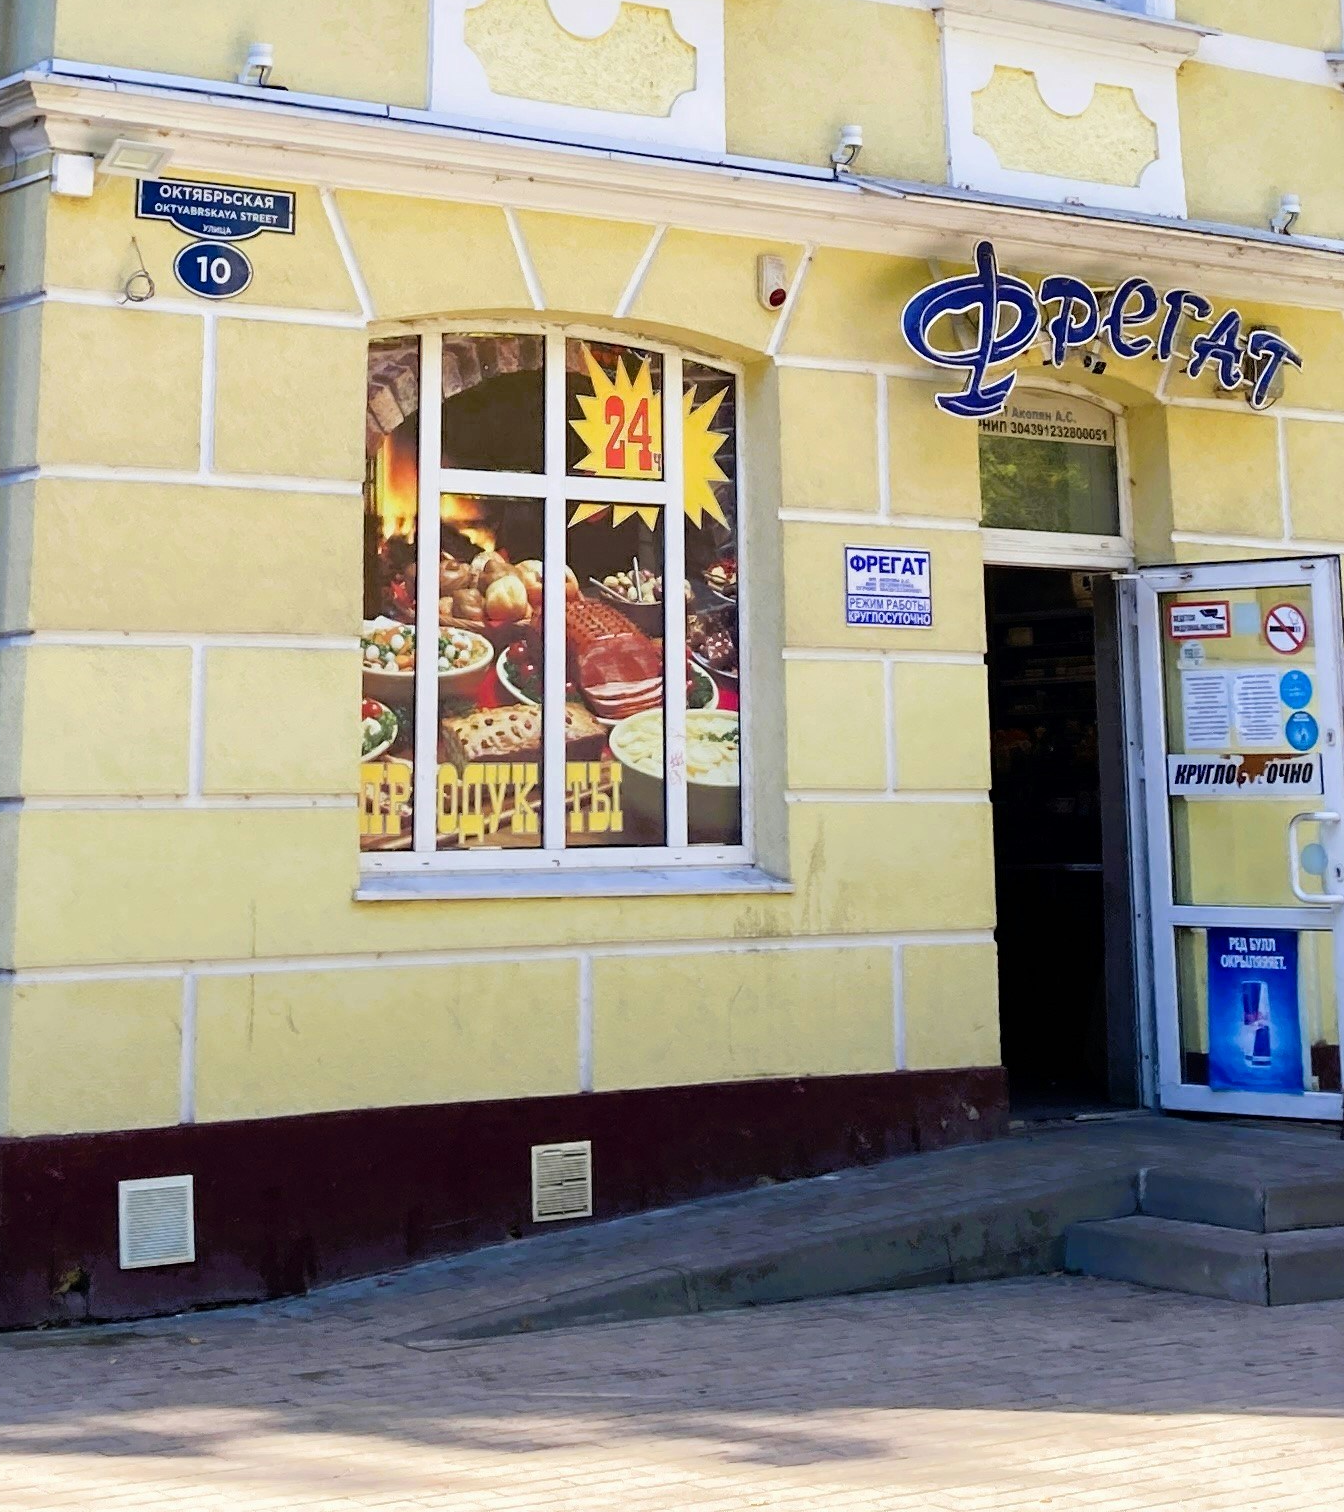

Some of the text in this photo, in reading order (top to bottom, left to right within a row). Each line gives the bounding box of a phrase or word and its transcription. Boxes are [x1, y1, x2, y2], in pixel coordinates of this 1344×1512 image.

[159, 184, 275, 210] ОКТЯБРЬСКАЯ
[154, 202, 279, 225] OKTYABRSKAYA STREET
[202, 223, 233, 236] УЛИЦА
[196, 256, 232, 285] 10
[849, 554, 927, 576] ФРЕГАТ
[849, 597, 884, 610] РЕЖИМ
[848, 610, 931, 625] КРУГЛОСУТОЧНО
[359, 761, 624, 845] ПРОДУКТЫ
[1228, 937, 1276, 953] РЕД БУЛЛ
